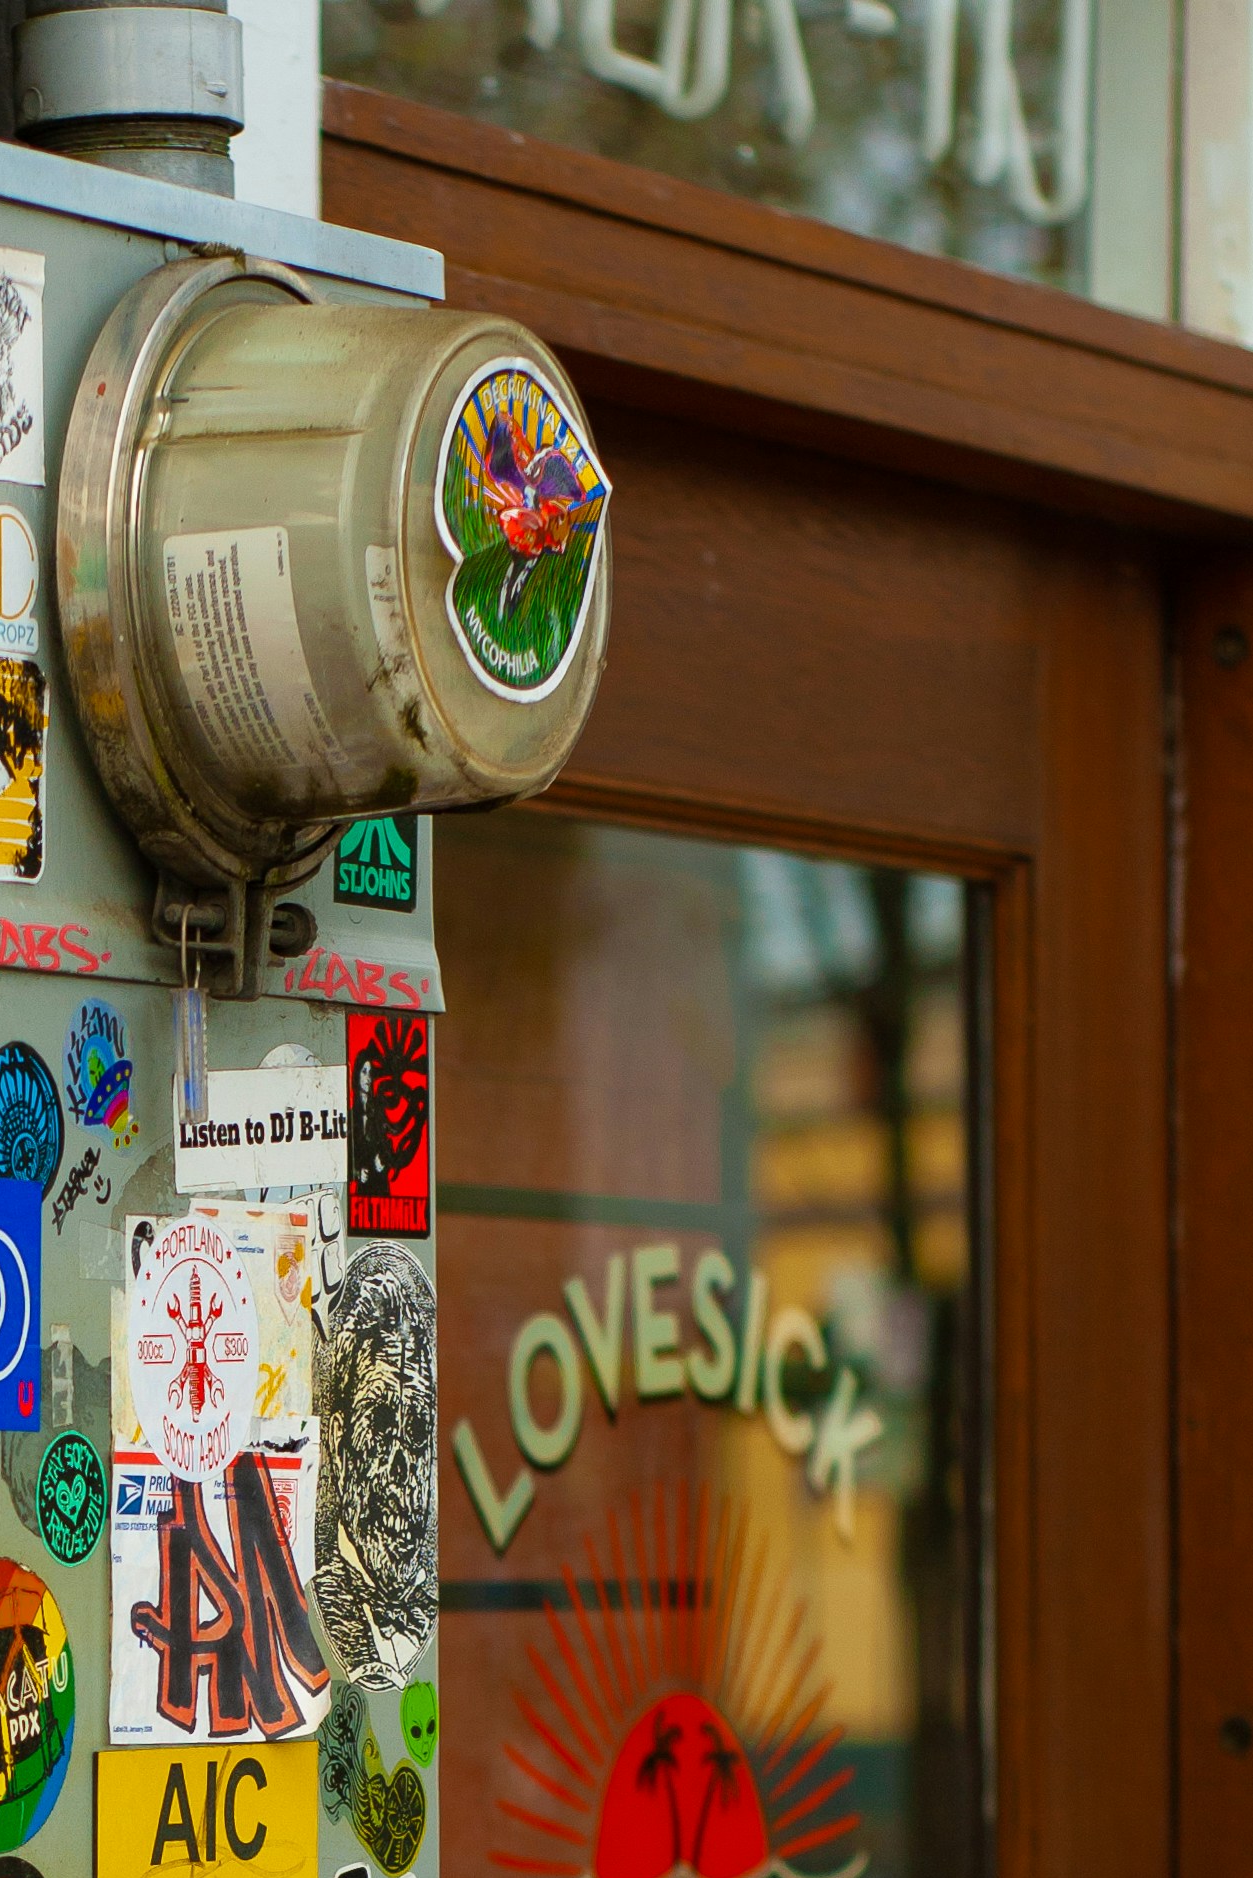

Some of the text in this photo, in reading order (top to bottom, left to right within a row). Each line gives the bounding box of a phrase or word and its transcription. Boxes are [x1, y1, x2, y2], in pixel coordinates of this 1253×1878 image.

[483, 379, 588, 476] DECRIMINALIZE
[466, 605, 539, 678] MYCOPHILIA
[180, 1110, 348, 1149] Listen to DJ B-Lit
[161, 1225, 225, 1268] PORTLAND
[137, 1340, 164, 1360] 300cc
[224, 1337, 249, 1357] $300
[452, 1242, 885, 1556] LOVESICK
[42, 1442, 94, 1500] STAY SOFT
[163, 1415, 195, 1472] SCOOT
[9, 1709, 41, 1746] PDX
[150, 1757, 268, 1866] AIC
